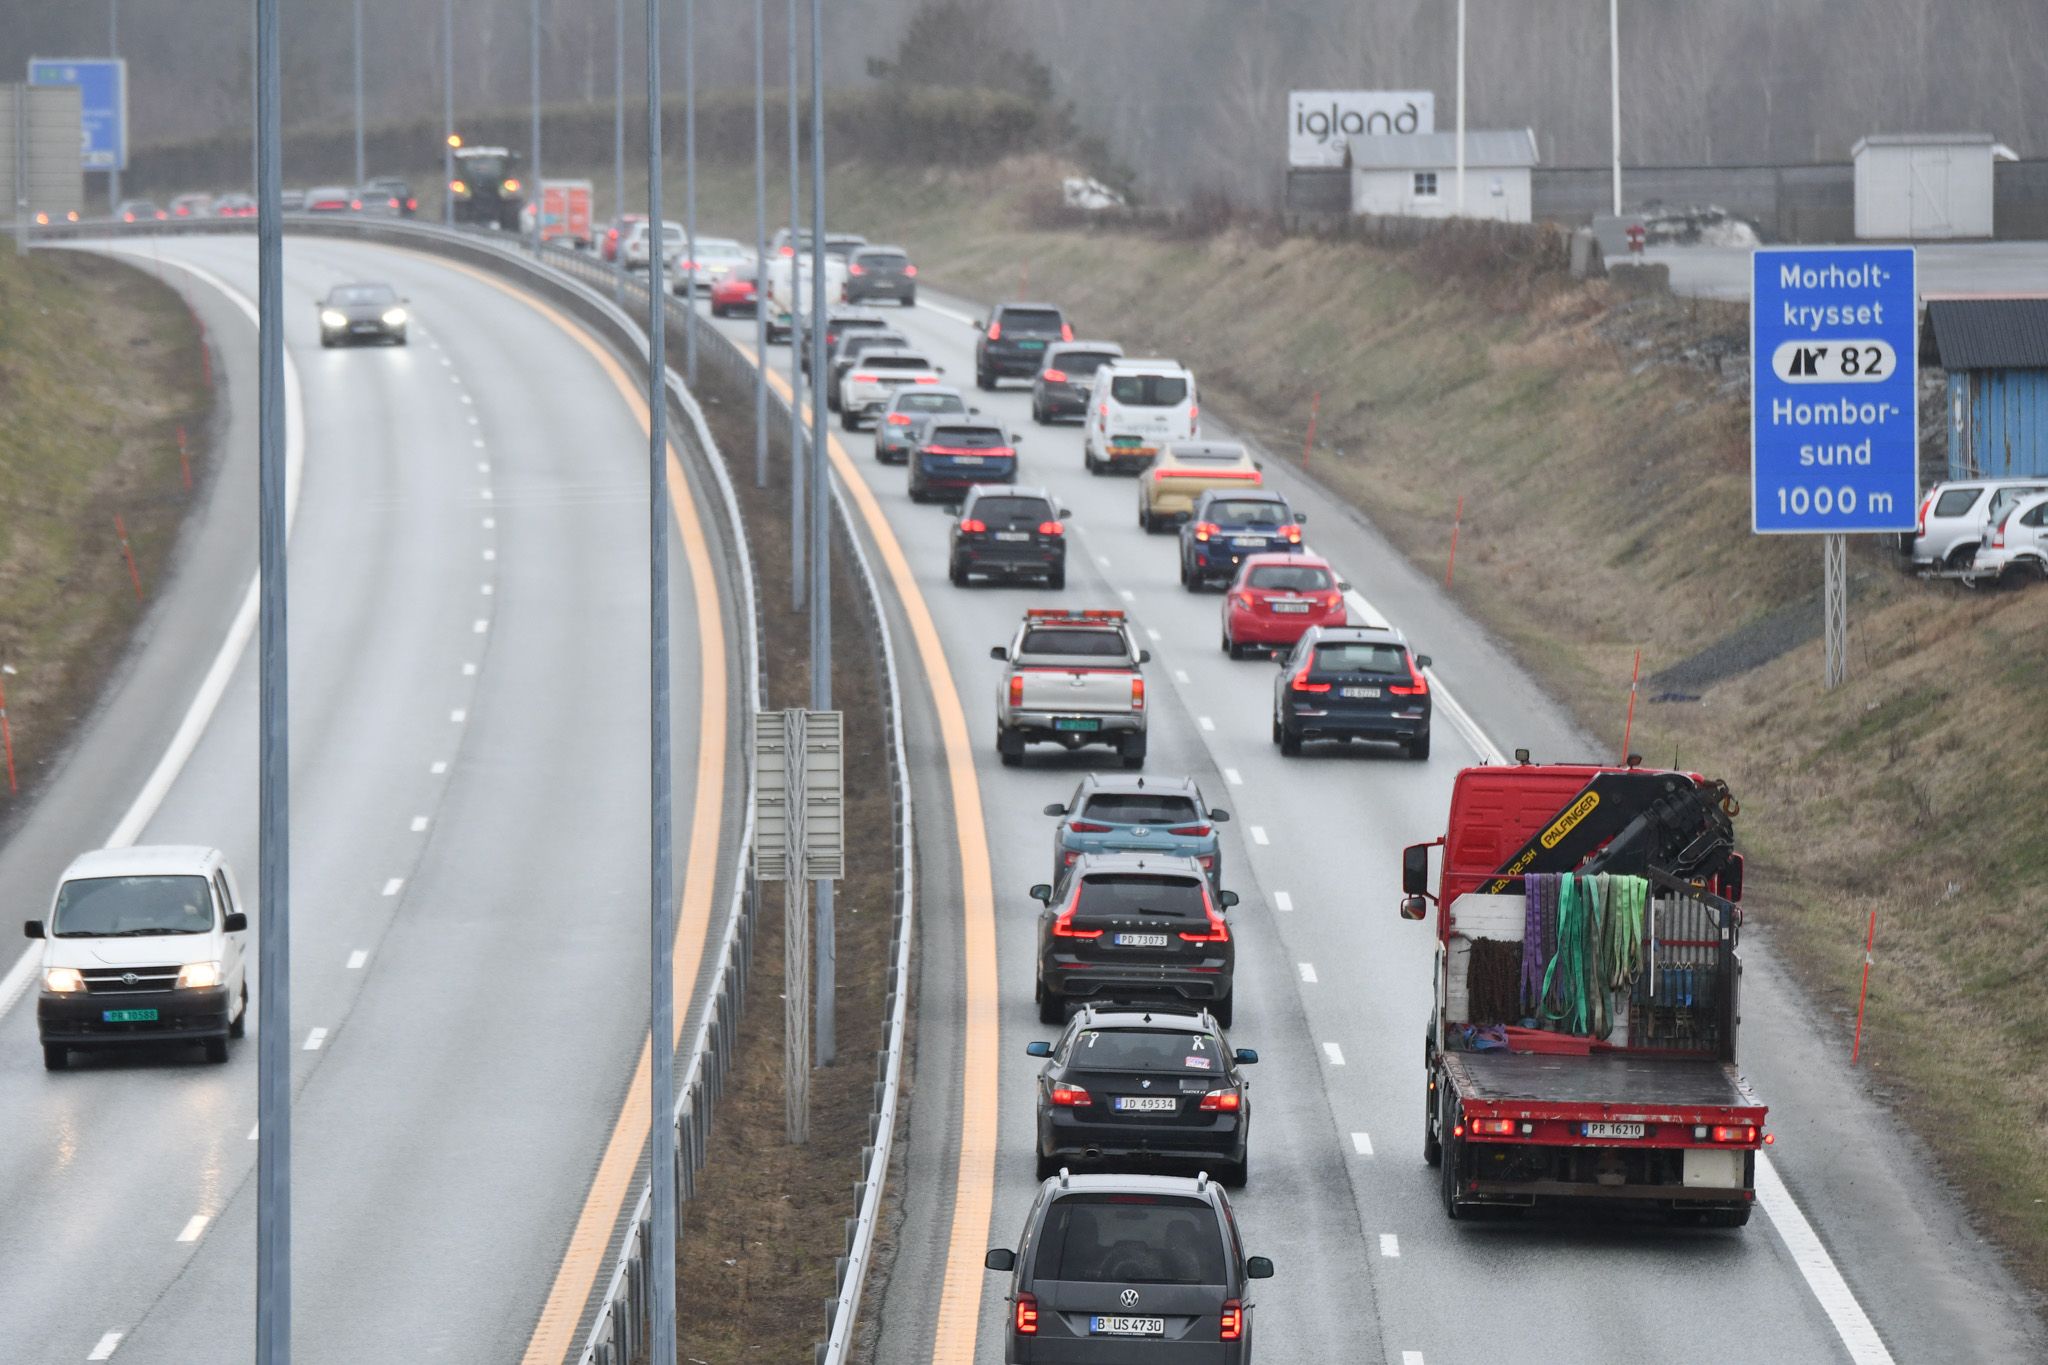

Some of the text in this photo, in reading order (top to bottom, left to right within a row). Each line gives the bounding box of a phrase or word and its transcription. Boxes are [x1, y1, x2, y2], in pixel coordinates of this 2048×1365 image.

[1297, 103, 1418, 143] igland
[1780, 263, 1890, 288] Morholt-
[1783, 302, 1883, 331] krysset
[1840, 347, 1882, 375] 82
[1773, 398, 1900, 425] Hombor-
[1800, 438, 1871, 466] sund
[1778, 487, 1893, 515] 1000 m
[1543, 795, 1597, 846] PALFINGER
[1122, 935, 1165, 945] PD 73073
[1123, 1098, 1174, 1109] JD 49534
[1592, 1124, 1641, 1135] PR 16210
[1098, 1318, 1161, 1332] B US 4730
